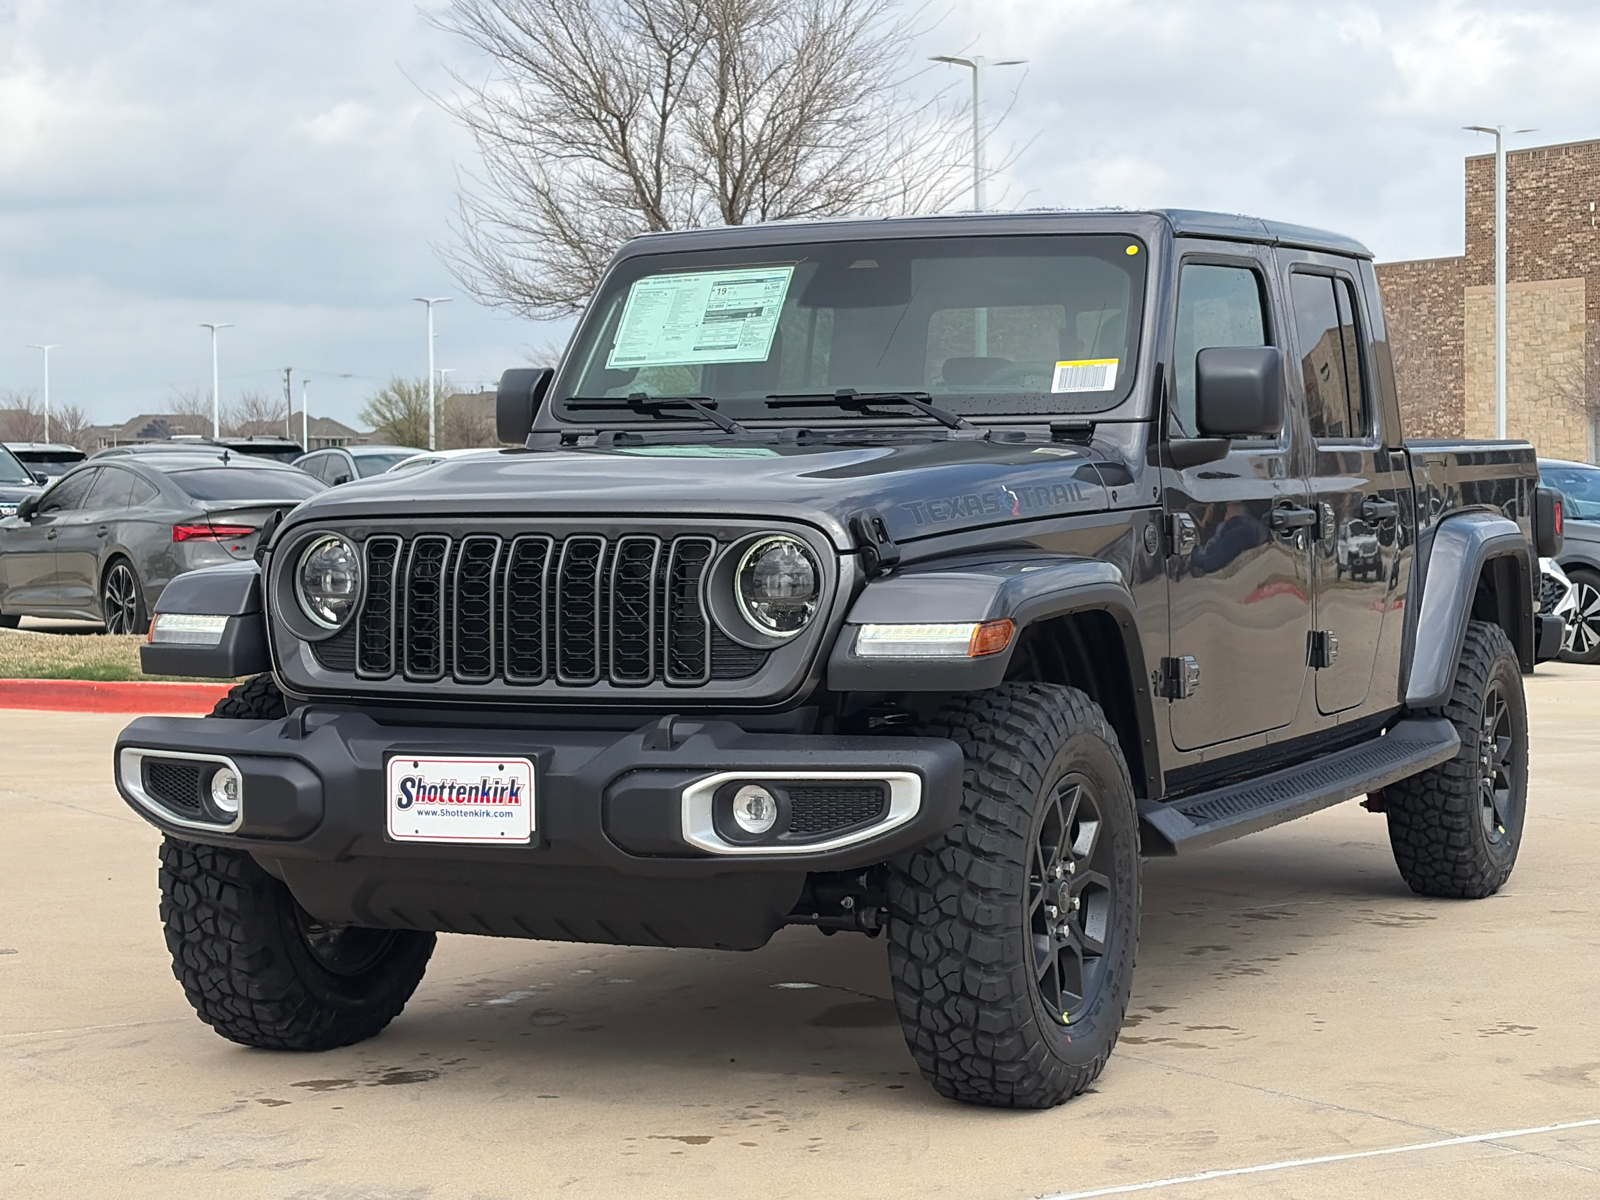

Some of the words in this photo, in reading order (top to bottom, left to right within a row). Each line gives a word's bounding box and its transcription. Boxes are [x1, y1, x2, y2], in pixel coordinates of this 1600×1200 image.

[717, 287, 728, 296] 19
[900, 491, 1000, 526] TEXAS
[1017, 482, 1090, 508] TRAIL
[397, 775, 523, 809] Shottenkirk
[416, 808, 514, 818] www.Shottenkirk.com
